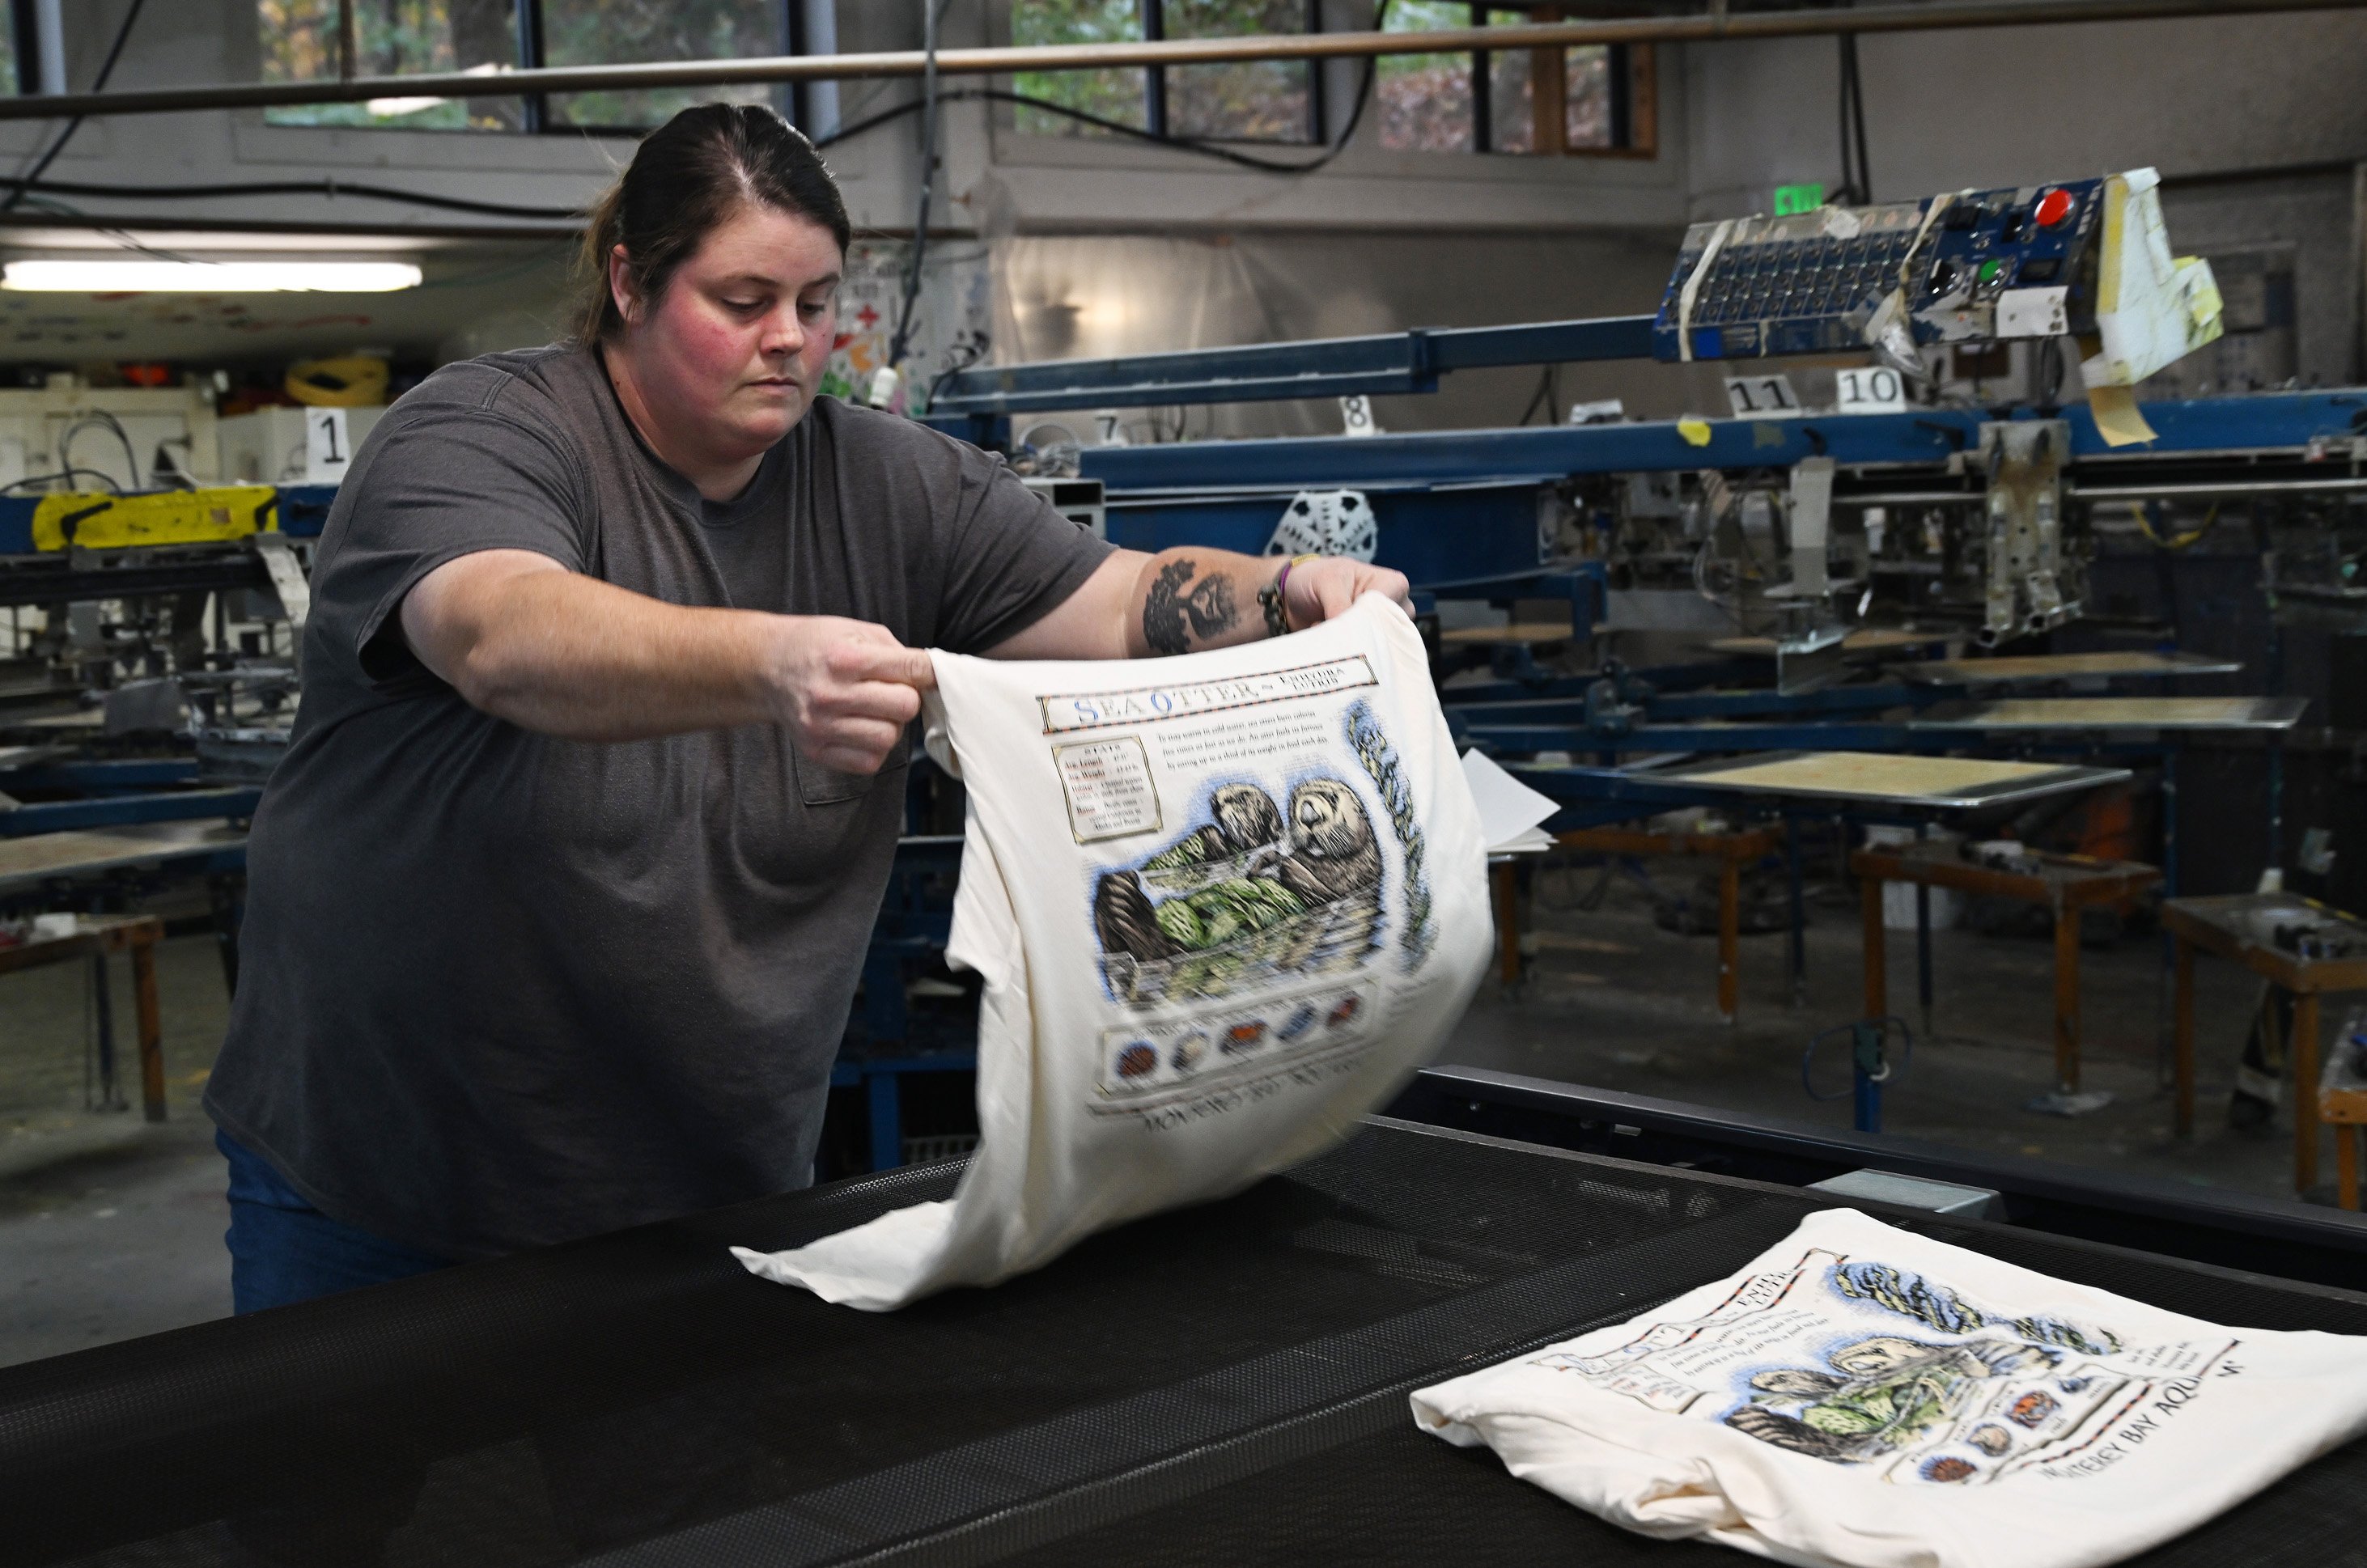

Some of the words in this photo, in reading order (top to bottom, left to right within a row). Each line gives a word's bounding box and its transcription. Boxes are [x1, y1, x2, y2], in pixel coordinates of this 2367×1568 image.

[1730, 379, 1795, 411] 11
[1843, 370, 1897, 404] 10
[1095, 416, 1118, 439] 7
[1345, 397, 1368, 428] 8
[320, 415, 345, 464] 1
[1075, 696, 1144, 724] SEA
[1150, 681, 1261, 714] OTTER
[2119, 1413, 2161, 1444] BAY
